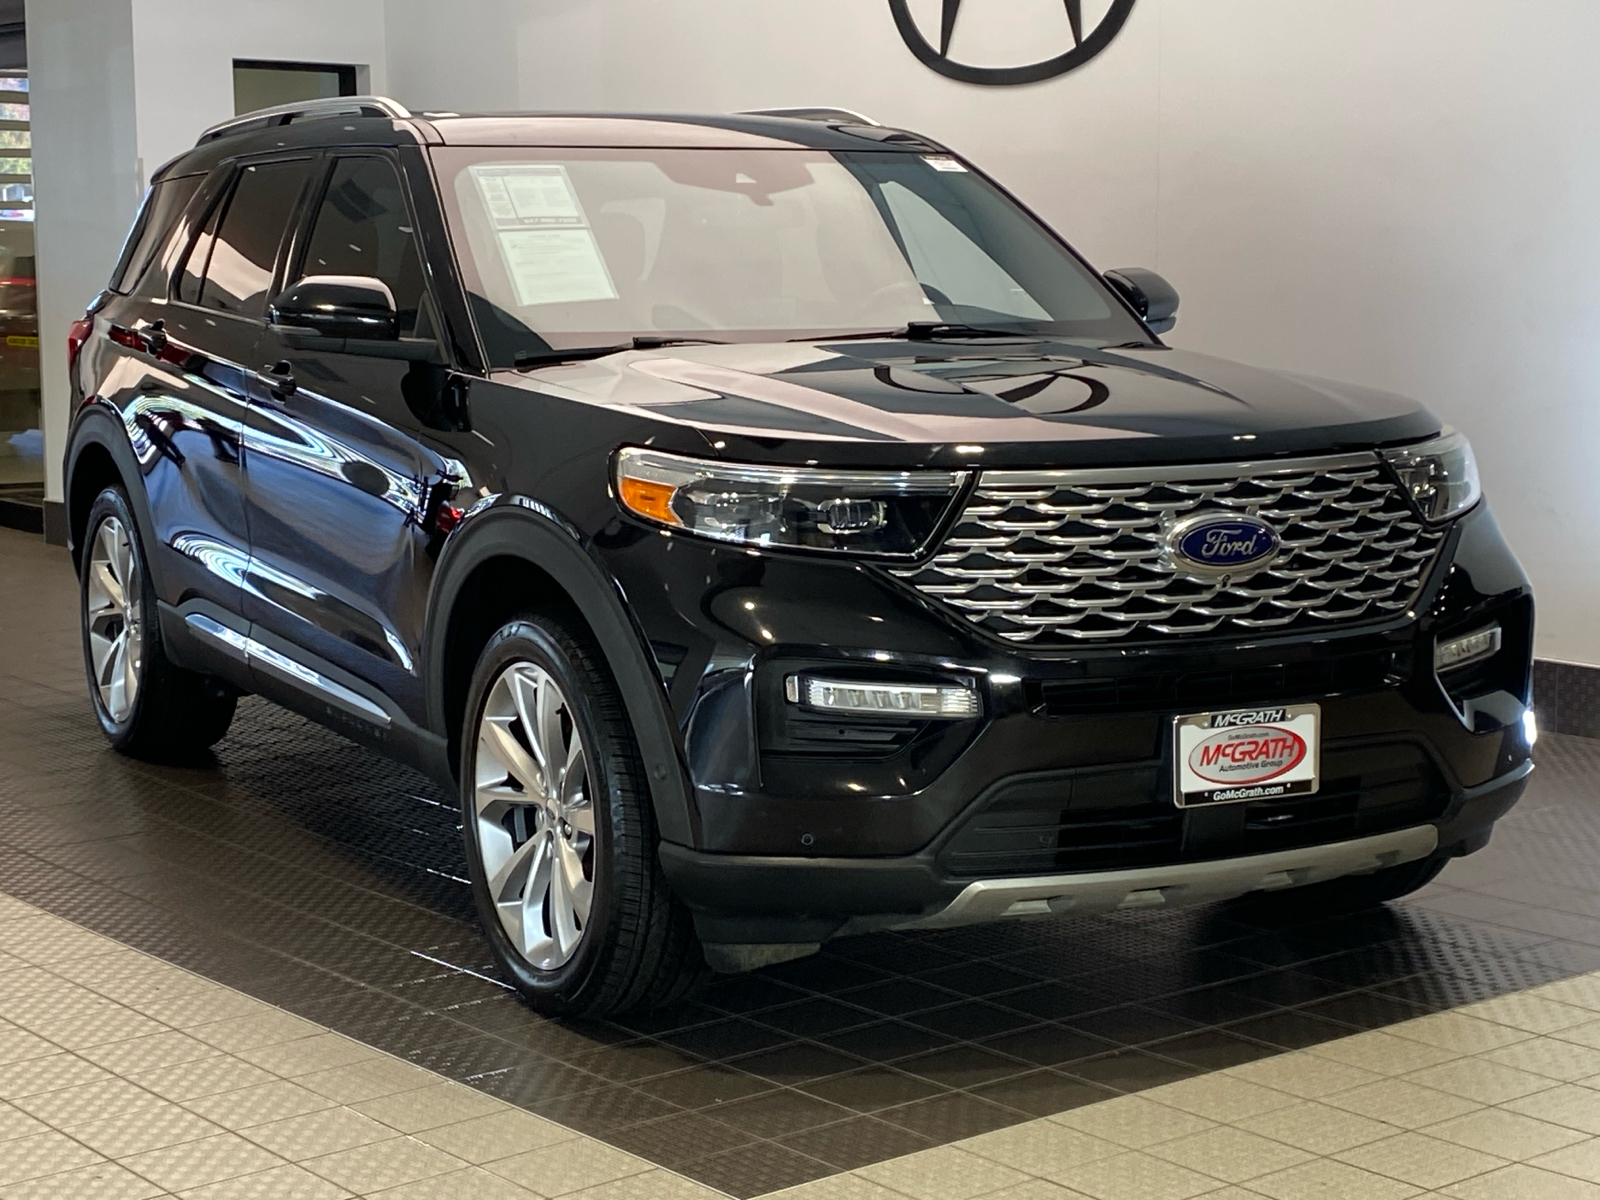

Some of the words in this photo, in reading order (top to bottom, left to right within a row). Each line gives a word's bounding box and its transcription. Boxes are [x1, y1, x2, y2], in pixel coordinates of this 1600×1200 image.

[1202, 529, 1257, 557] Ford
[1219, 762, 1259, 773] Automotive
[1261, 760, 1283, 769] Group
[1213, 786, 1284, 801] GoMcGrath.com
